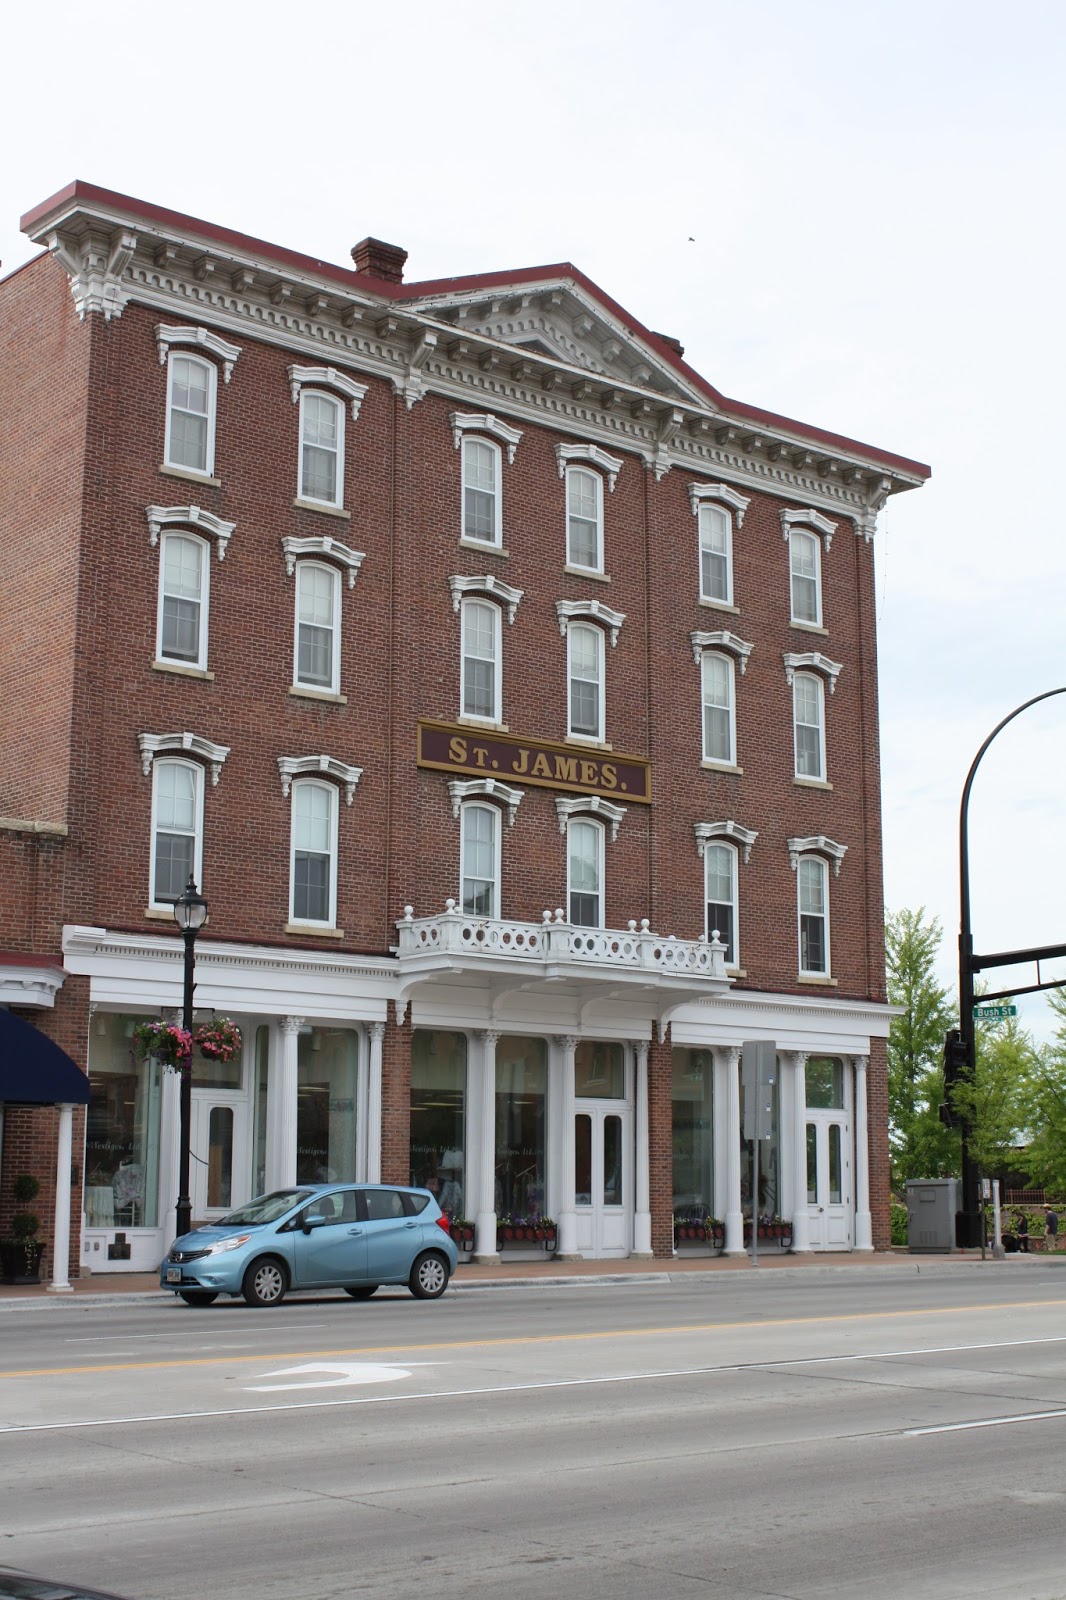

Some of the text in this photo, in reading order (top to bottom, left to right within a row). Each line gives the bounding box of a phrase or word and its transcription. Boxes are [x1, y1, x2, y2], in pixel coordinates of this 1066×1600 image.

[512, 749, 627, 790] JAMES.
[977, 1006, 1012, 1017] Bush St
